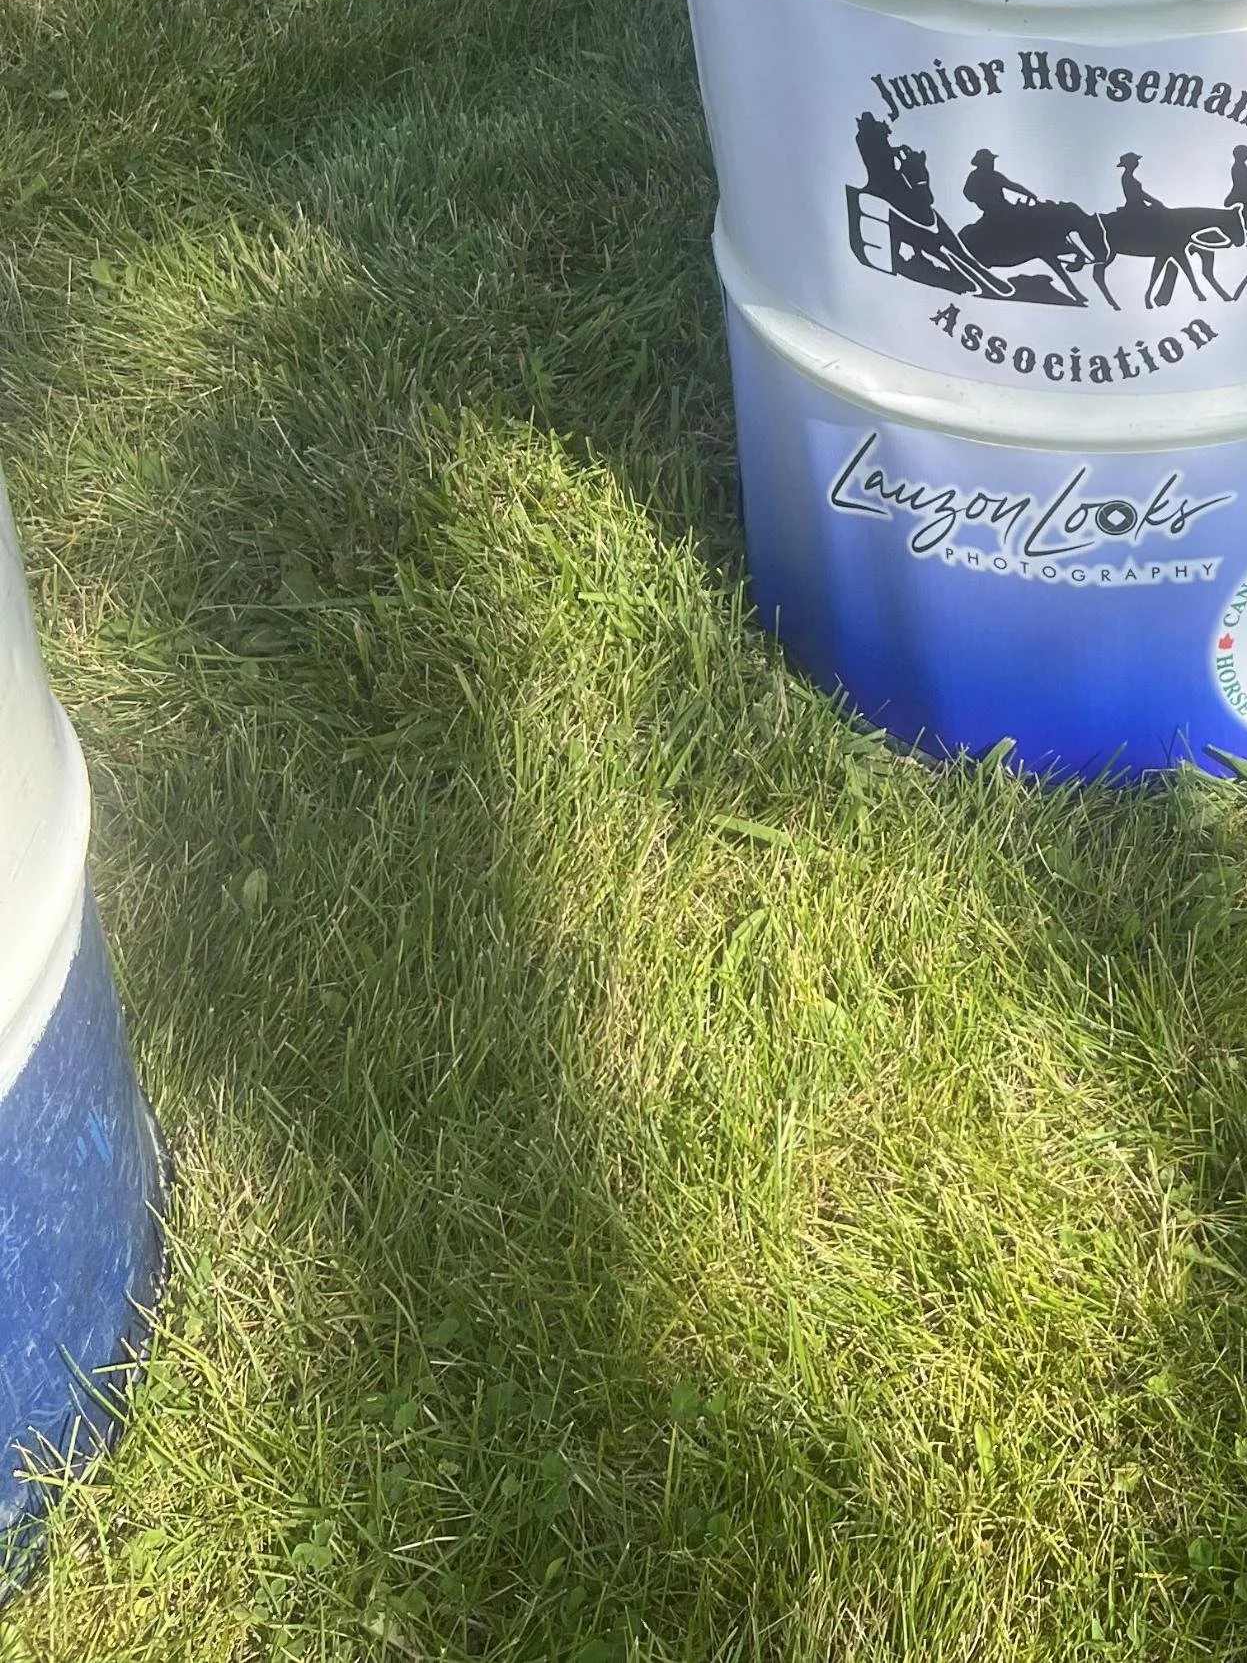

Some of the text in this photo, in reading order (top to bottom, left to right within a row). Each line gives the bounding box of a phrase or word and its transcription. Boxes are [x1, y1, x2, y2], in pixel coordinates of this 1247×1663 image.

[870, 58, 1005, 122] Junior
[929, 303, 1219, 384] Association
[831, 432, 1231, 557] Lauzon Looks
[945, 547, 1213, 582] PHOTOGRAPHY
